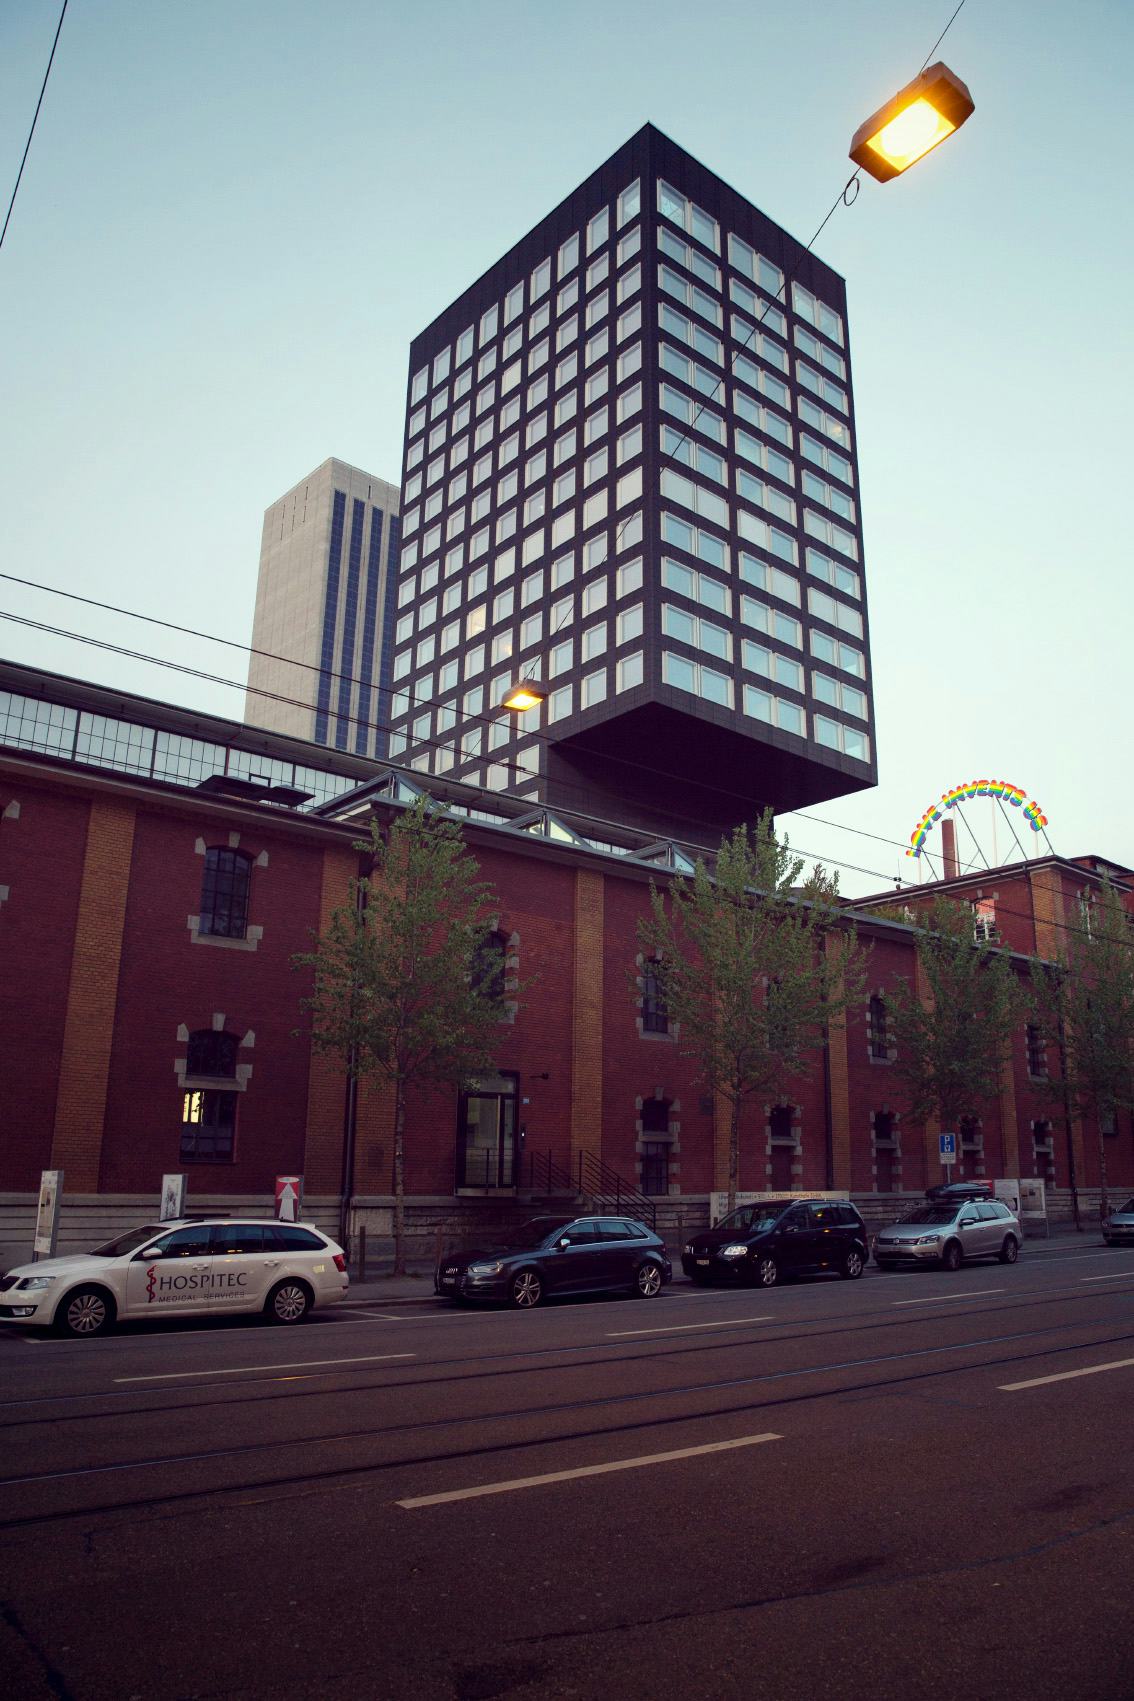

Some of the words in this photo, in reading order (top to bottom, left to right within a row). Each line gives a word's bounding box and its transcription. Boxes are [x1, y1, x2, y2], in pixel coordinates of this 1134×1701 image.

[905, 804, 943, 858] LOVE
[941, 779, 1027, 809] INVENTS
[1022, 800, 1049, 832] US
[159, 1272, 248, 1291] HOSPITEC
[158, 1293, 197, 1303] MEDICAL
[203, 1291, 246, 1301] SERVICES
